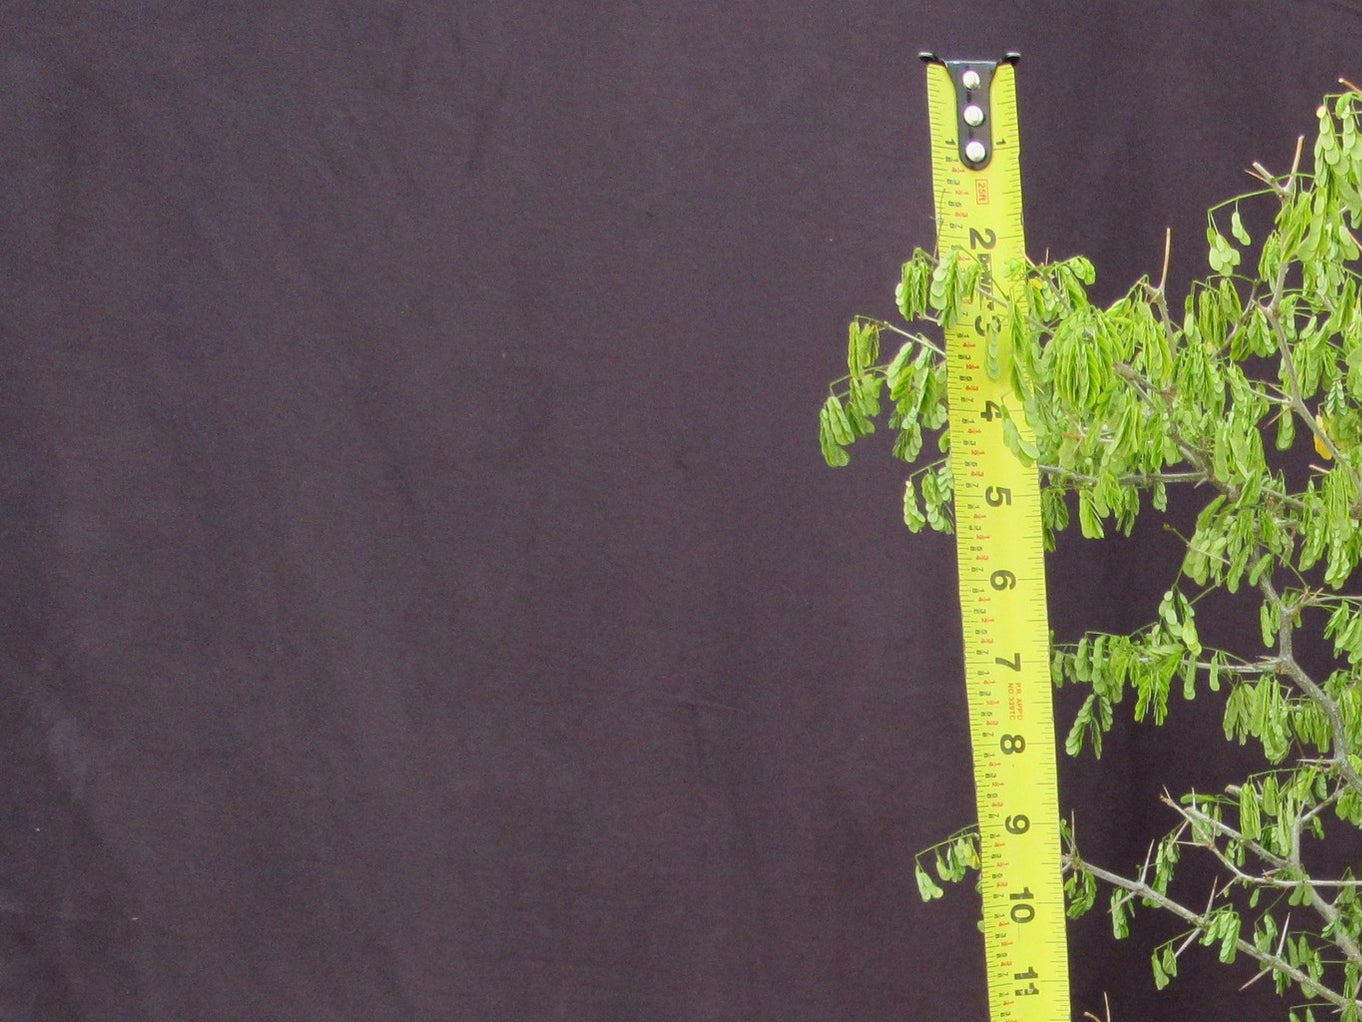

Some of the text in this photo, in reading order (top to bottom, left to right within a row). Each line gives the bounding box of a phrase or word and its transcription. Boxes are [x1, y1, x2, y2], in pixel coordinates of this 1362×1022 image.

[969, 227, 997, 250] 2
[980, 400, 1003, 422] 4
[985, 485, 1012, 508] 5
[990, 569, 1017, 591] 6
[995, 652, 1021, 672] 7
[1000, 733, 1026, 755] 8
[1005, 814, 1031, 835] 9
[1009, 886, 1036, 924] 10
[1014, 966, 1039, 996] 11
